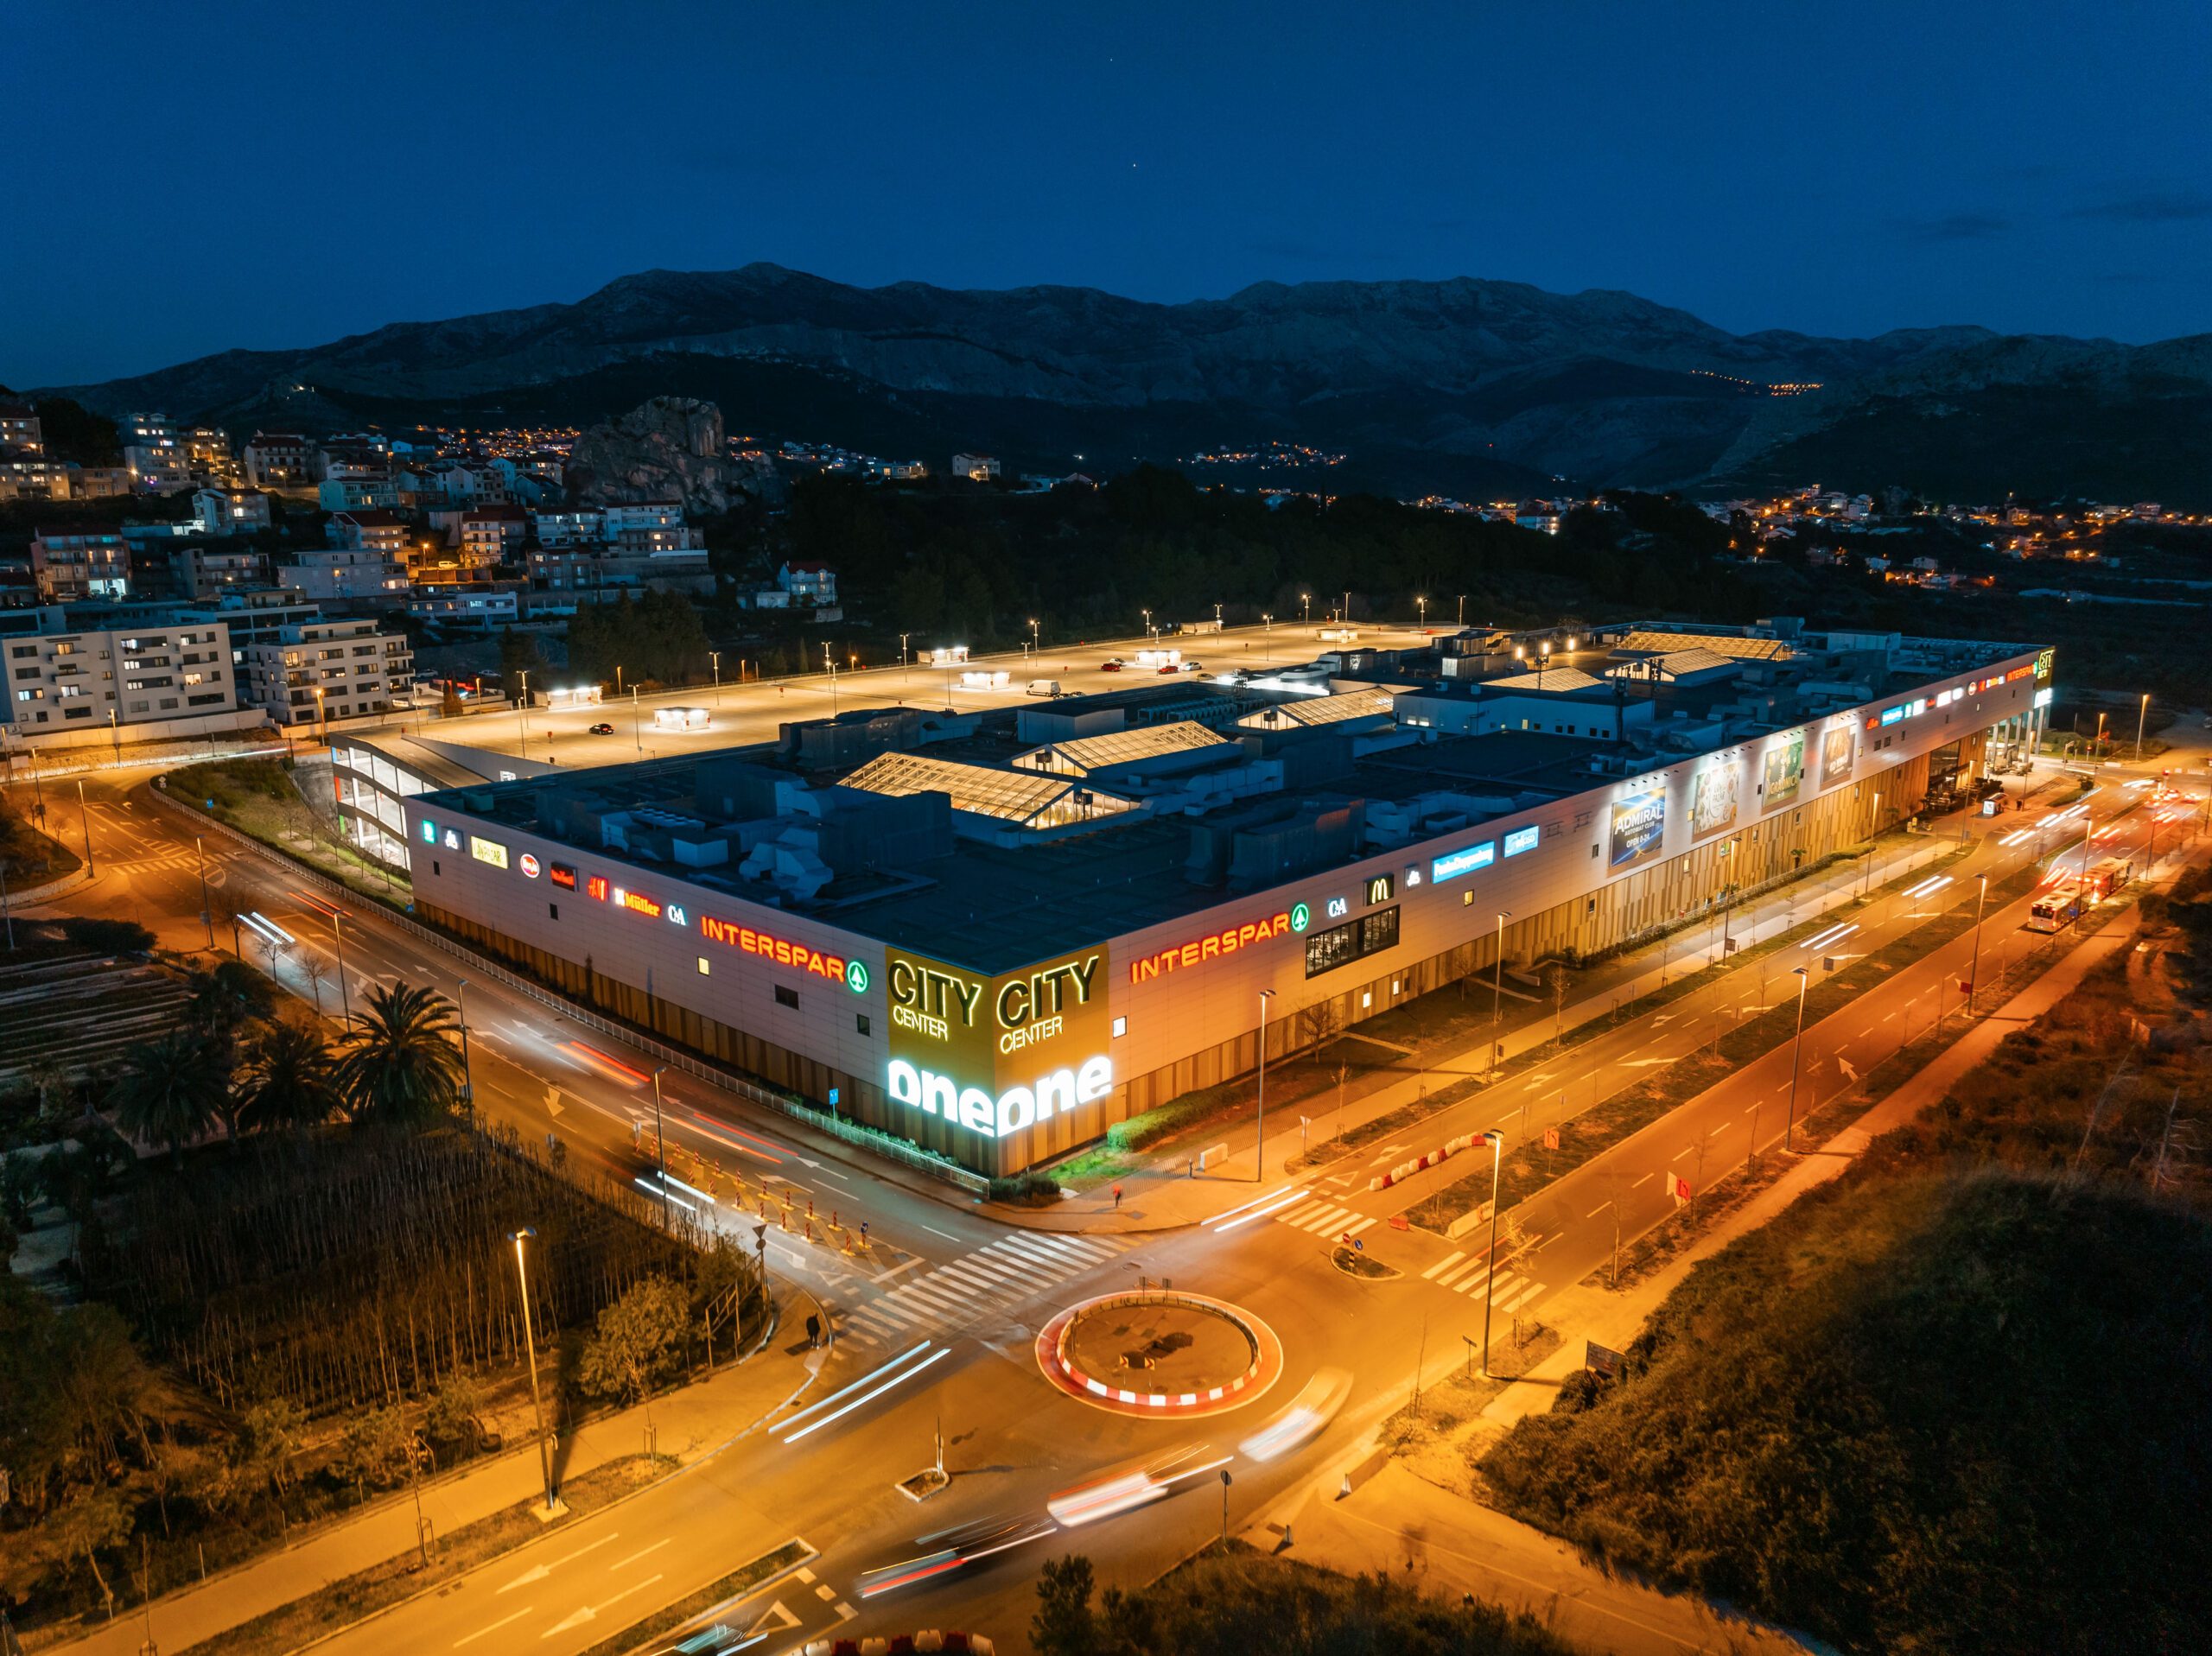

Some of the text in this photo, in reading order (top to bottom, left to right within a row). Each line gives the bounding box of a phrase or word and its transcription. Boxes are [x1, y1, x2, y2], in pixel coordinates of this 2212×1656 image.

[1614, 803, 1663, 835] ADMIRAL
[1625, 835, 1640, 848] OPEN
[625, 892, 661, 917] Müller
[701, 916, 845, 983] INTERSPAR
[1130, 913, 1290, 984] INTERSPAR
[888, 959, 982, 1027] CITY
[893, 1005, 949, 1043] CENTER
[996, 955, 1100, 1030] CITY
[1000, 1015, 1063, 1055] CENTER
[888, 1059, 995, 1139] one
[997, 1056, 1112, 1139] one
